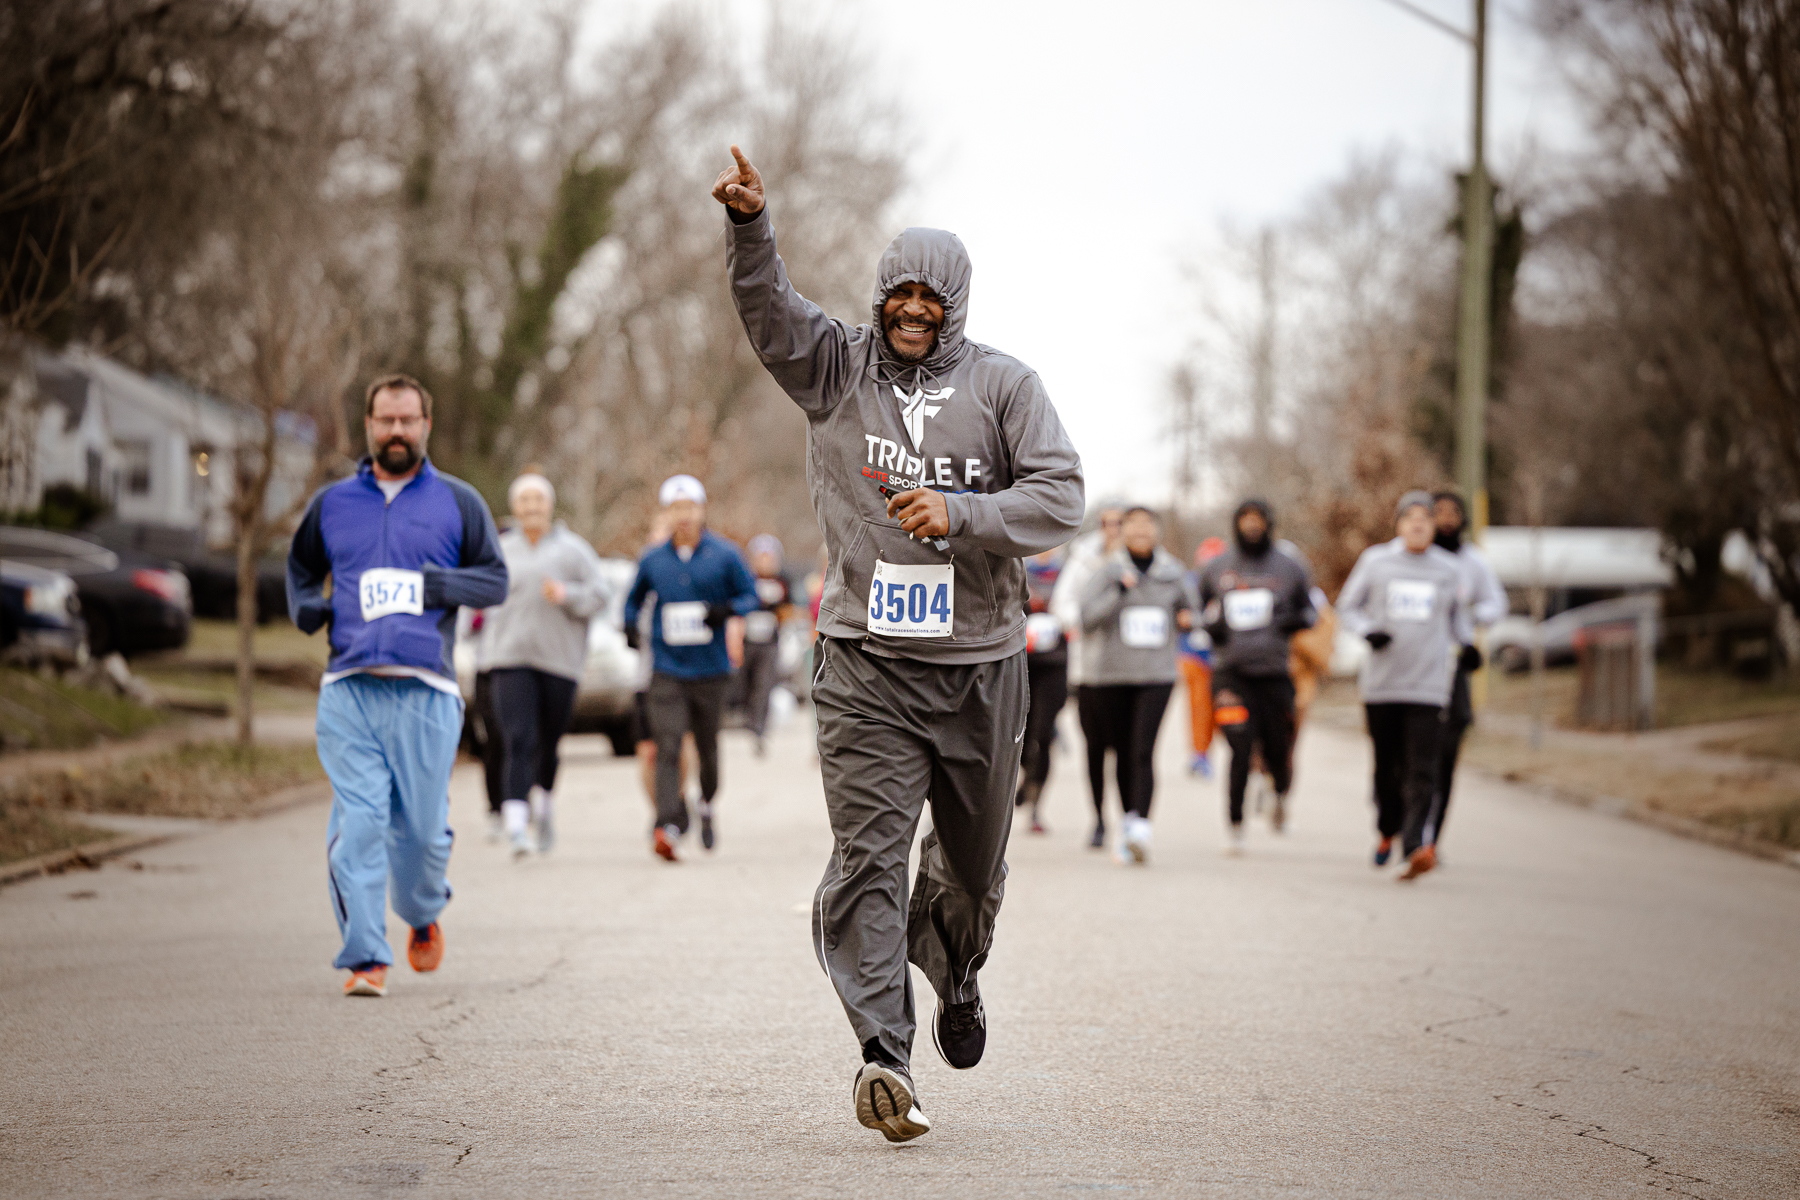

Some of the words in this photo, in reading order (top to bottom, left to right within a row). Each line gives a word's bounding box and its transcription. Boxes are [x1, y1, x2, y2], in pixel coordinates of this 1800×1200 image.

[865, 433, 953, 487] TRIPLE
[965, 458, 981, 486] F
[861, 466, 889, 483] ELITE
[365, 581, 417, 609] 3571
[870, 579, 951, 623] 3504
[875, 625, 941, 634] www.totalracesolutions.com
